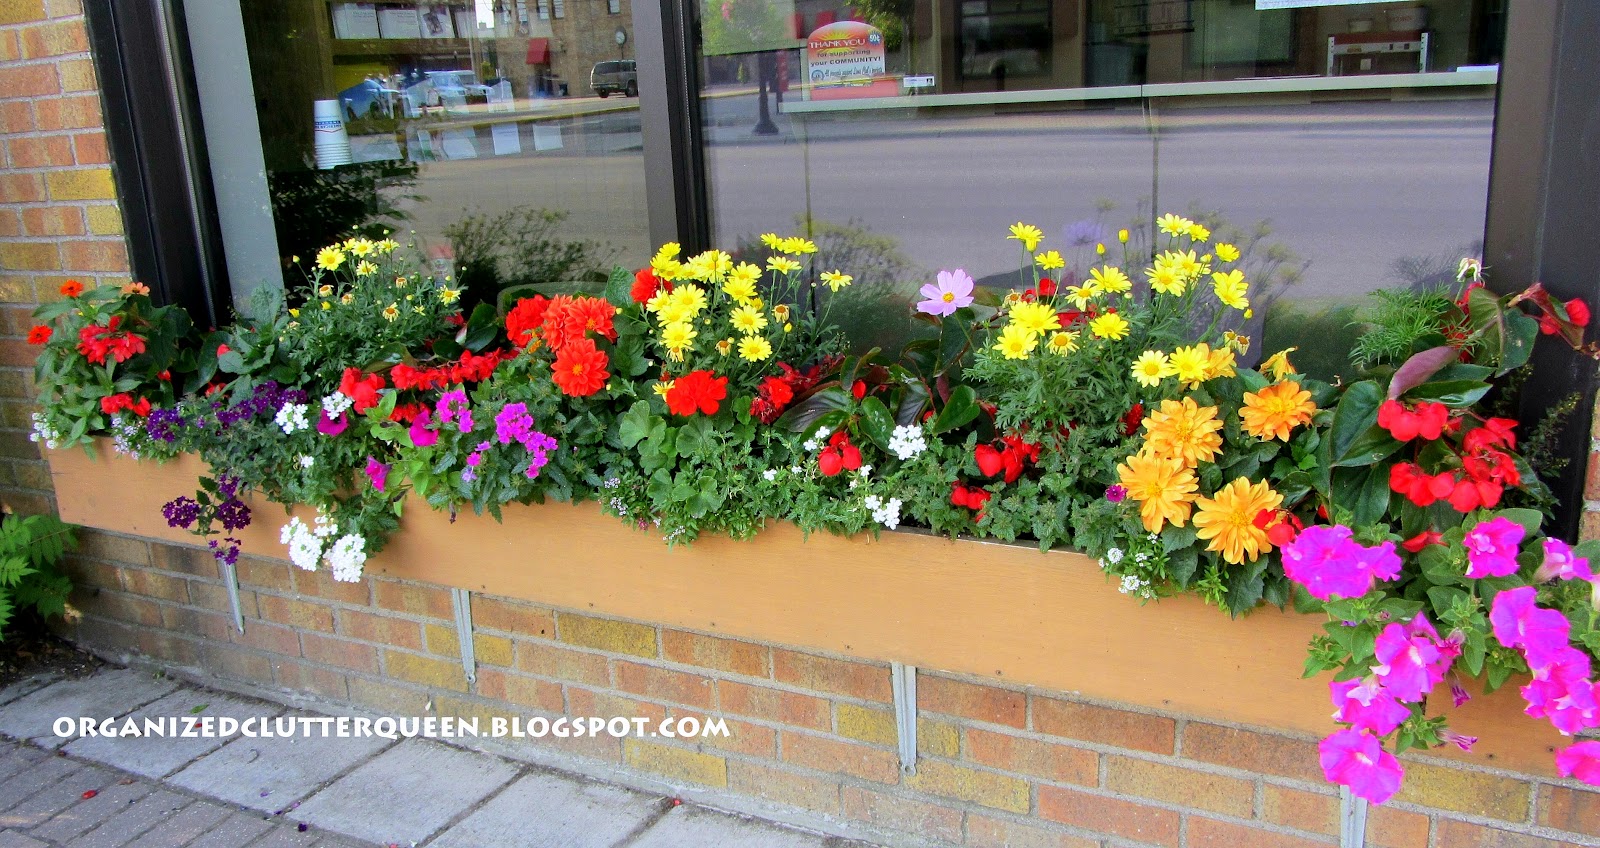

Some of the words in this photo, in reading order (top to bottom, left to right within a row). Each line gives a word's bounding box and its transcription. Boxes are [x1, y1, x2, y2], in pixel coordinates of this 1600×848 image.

[809, 40, 841, 49] THANK
[843, 38, 866, 46] YOU
[829, 49, 871, 57] supporting
[830, 56, 881, 65] COMMUNITY!
